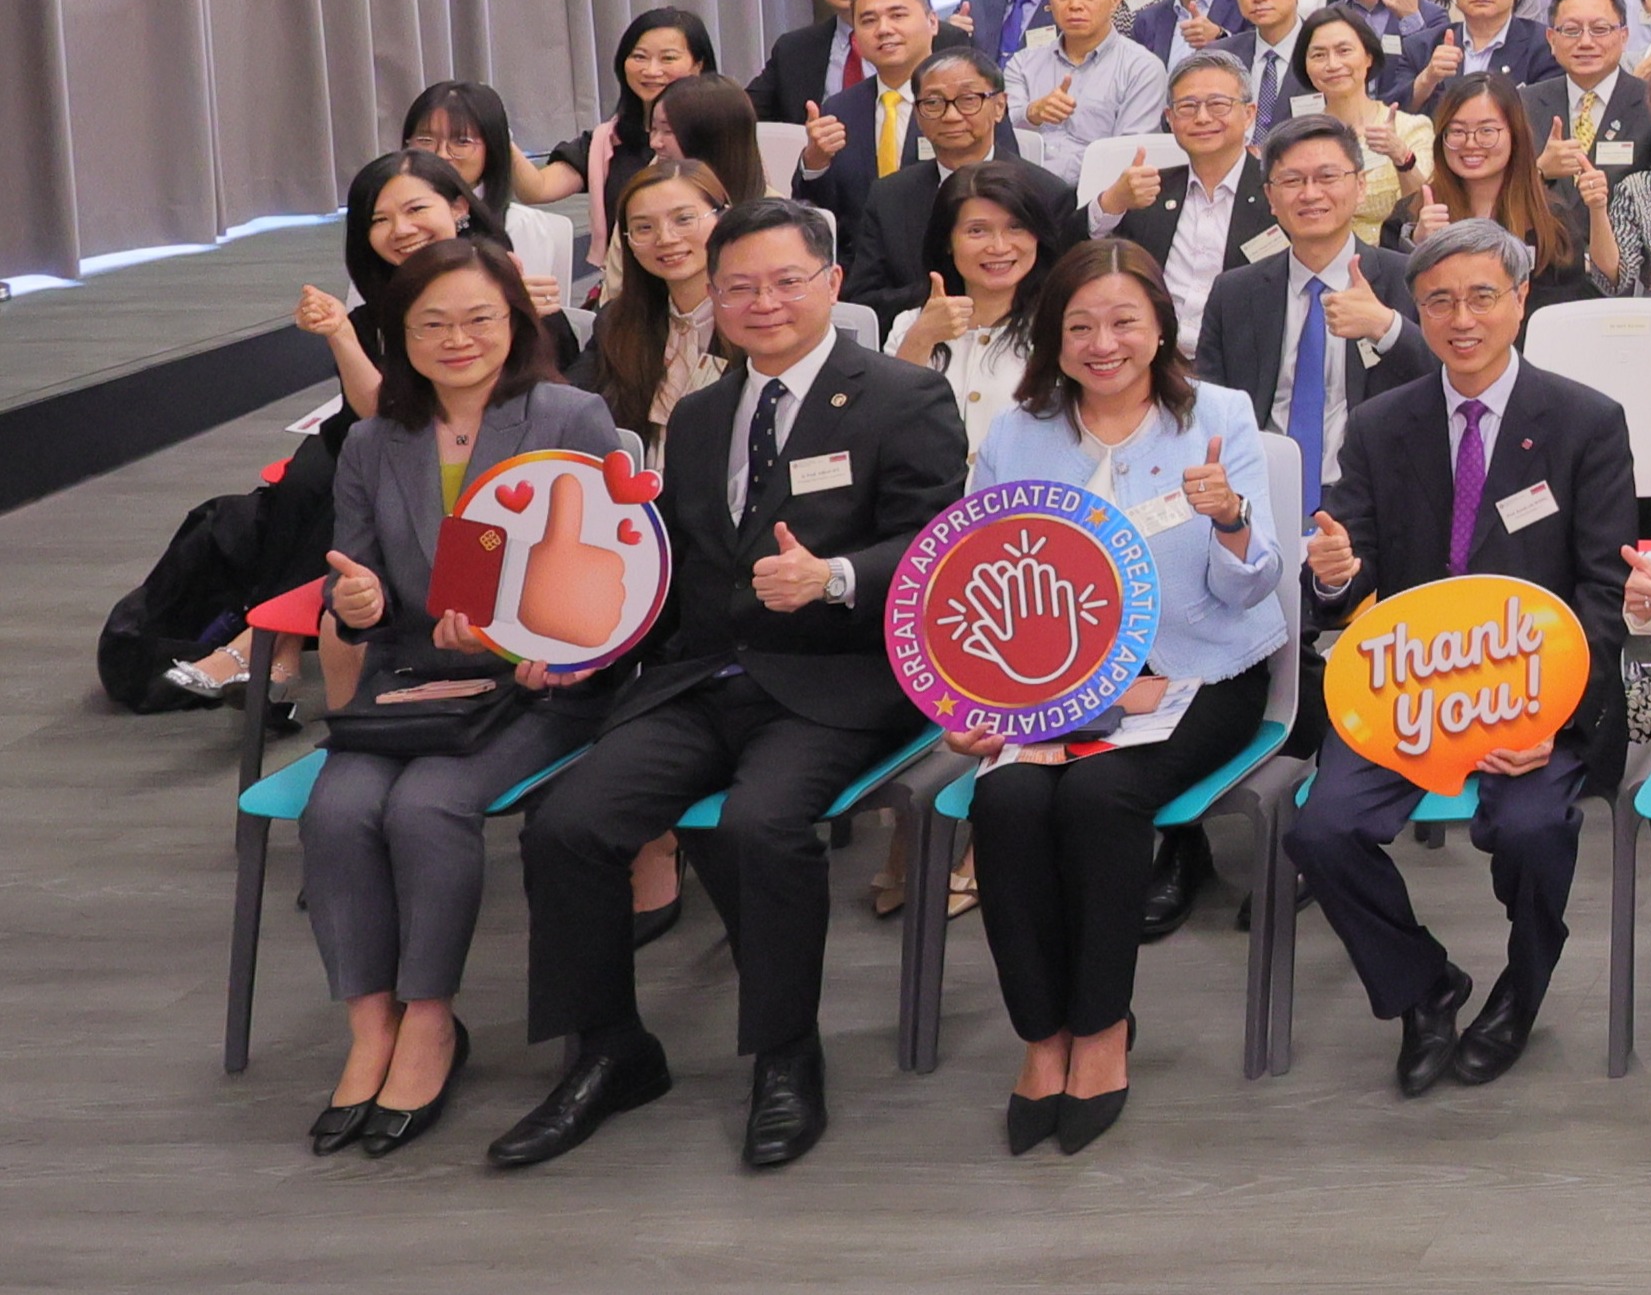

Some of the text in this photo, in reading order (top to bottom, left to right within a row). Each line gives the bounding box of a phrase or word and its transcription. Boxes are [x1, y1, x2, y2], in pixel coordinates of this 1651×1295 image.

[893, 485, 1082, 692] GREATLY APPRECIATED
[966, 529, 1153, 736] GREATLY APPRECIATED
[1358, 595, 1544, 689] Thank
[1396, 653, 1541, 755] You!
